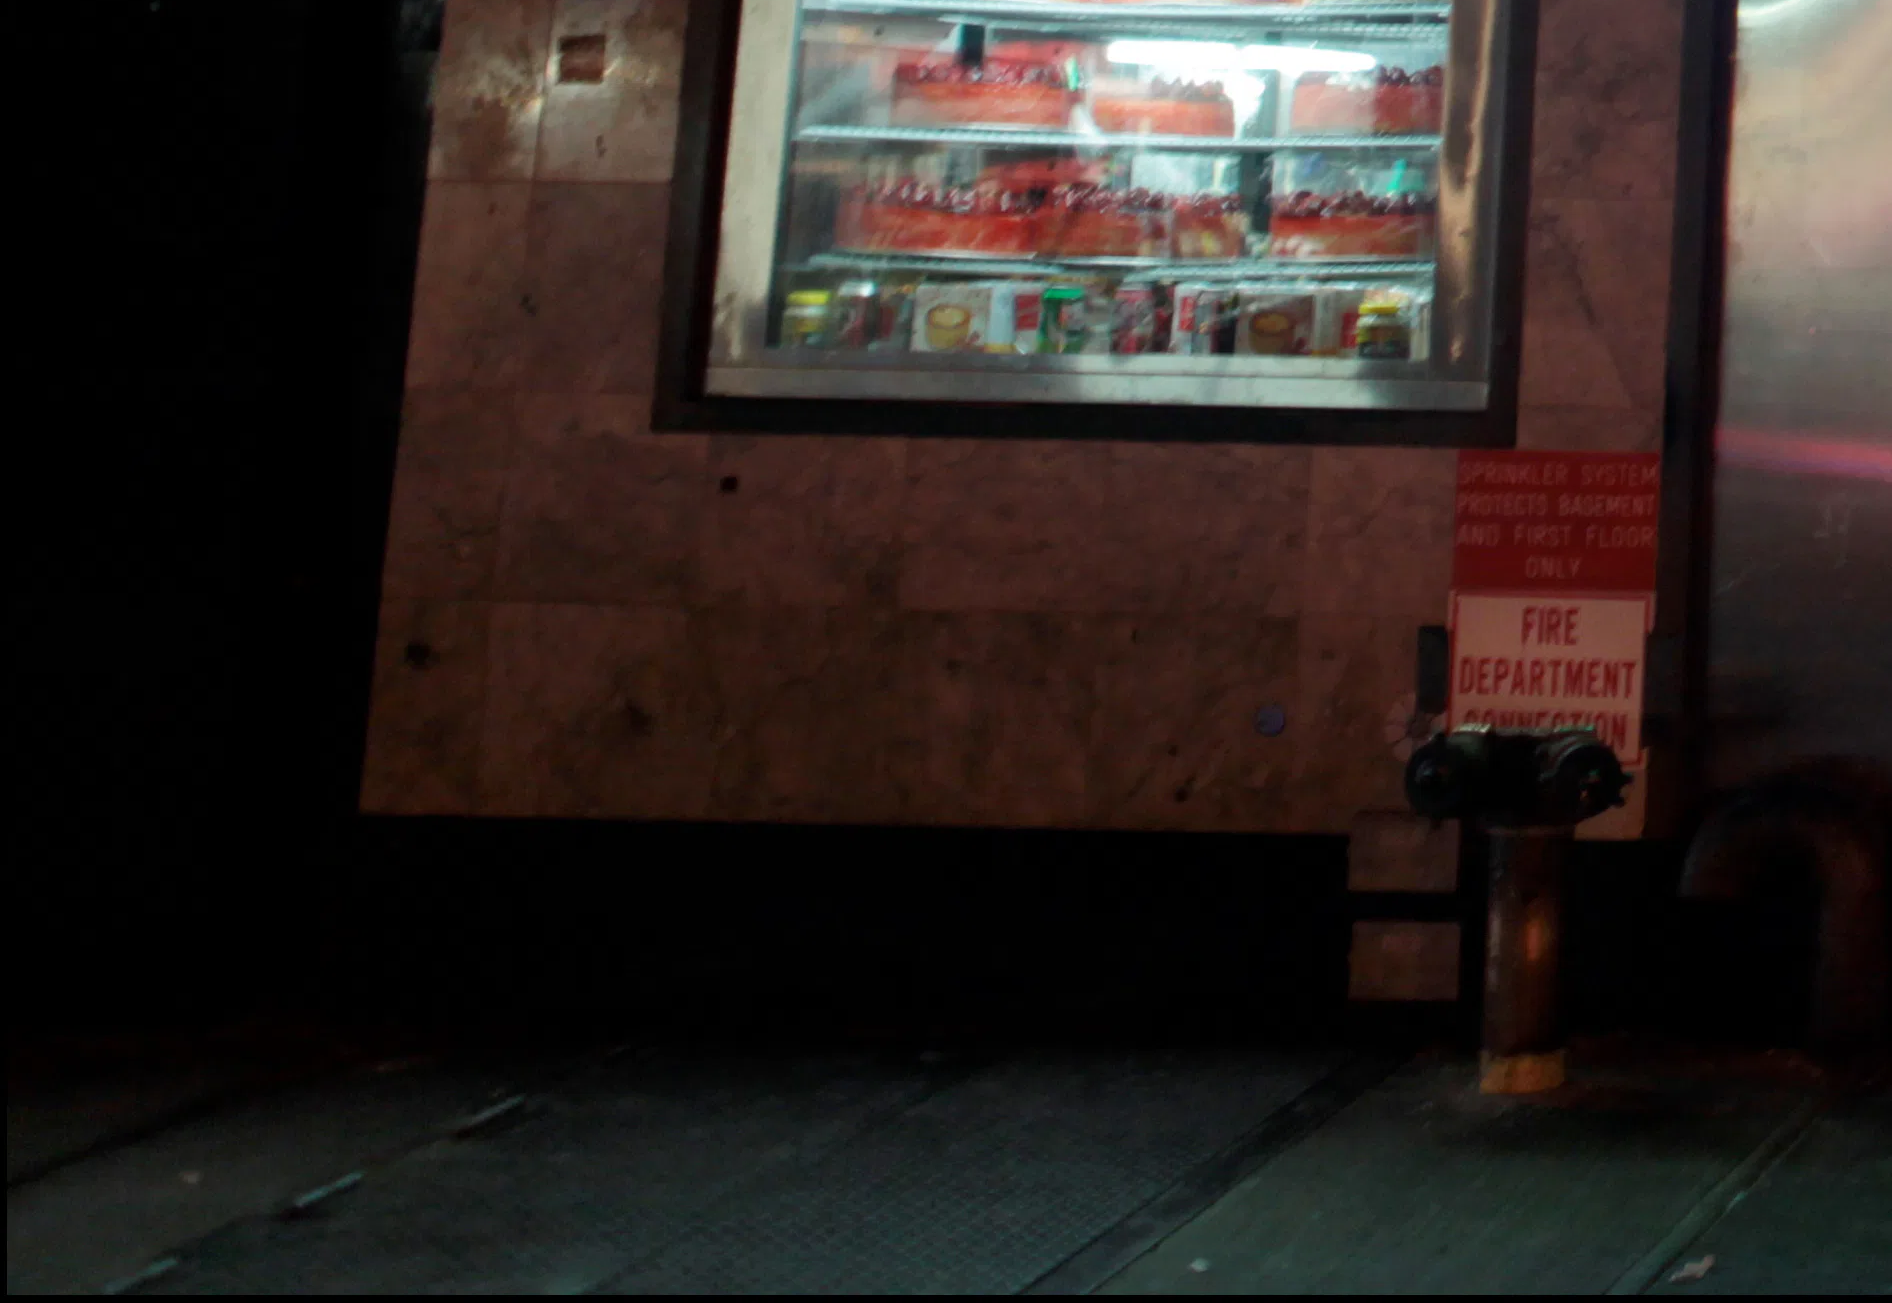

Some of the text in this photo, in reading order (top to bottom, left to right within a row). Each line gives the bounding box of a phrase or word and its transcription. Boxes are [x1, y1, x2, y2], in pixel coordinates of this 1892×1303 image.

[1458, 461, 1657, 488] SPRINKLER SYSTEM
[1456, 493, 1655, 518] PROTECTS BASEMENT
[1456, 524, 1654, 548] AND FIRST FLOOR
[1524, 556, 1582, 580] ONLY
[1521, 606, 1580, 646] FIRE
[1459, 658, 1637, 700] DEPARTMENT
